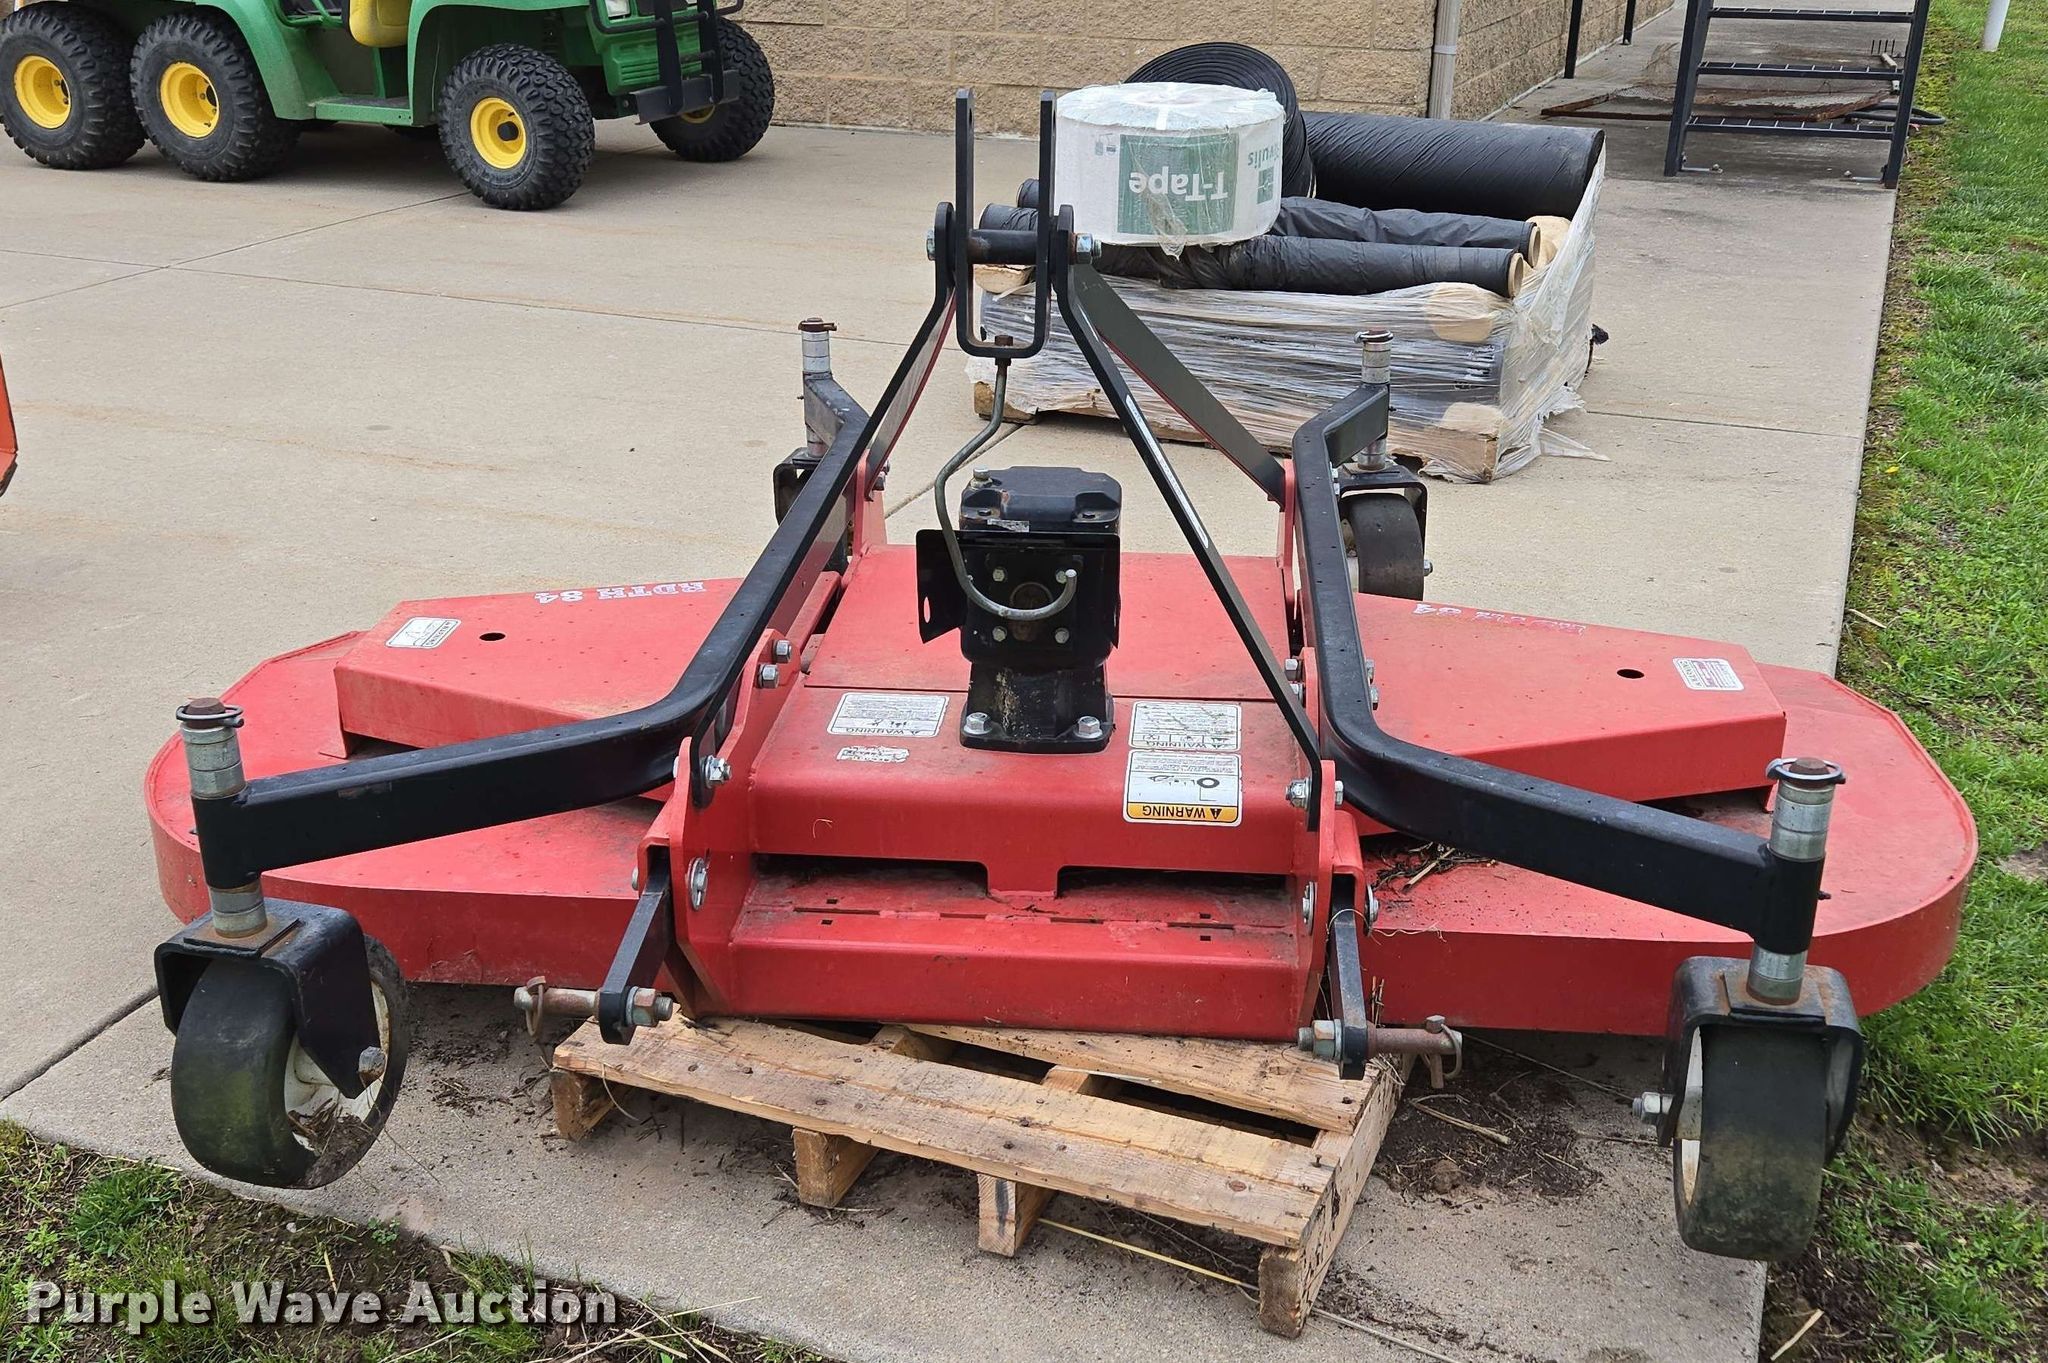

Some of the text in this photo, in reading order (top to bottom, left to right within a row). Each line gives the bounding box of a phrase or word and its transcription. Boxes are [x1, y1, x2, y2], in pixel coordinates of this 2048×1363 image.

[1128, 166, 1229, 202] T-Tape
[533, 581, 707, 604] RDTH 84
[1142, 805, 1206, 818] WARNING
